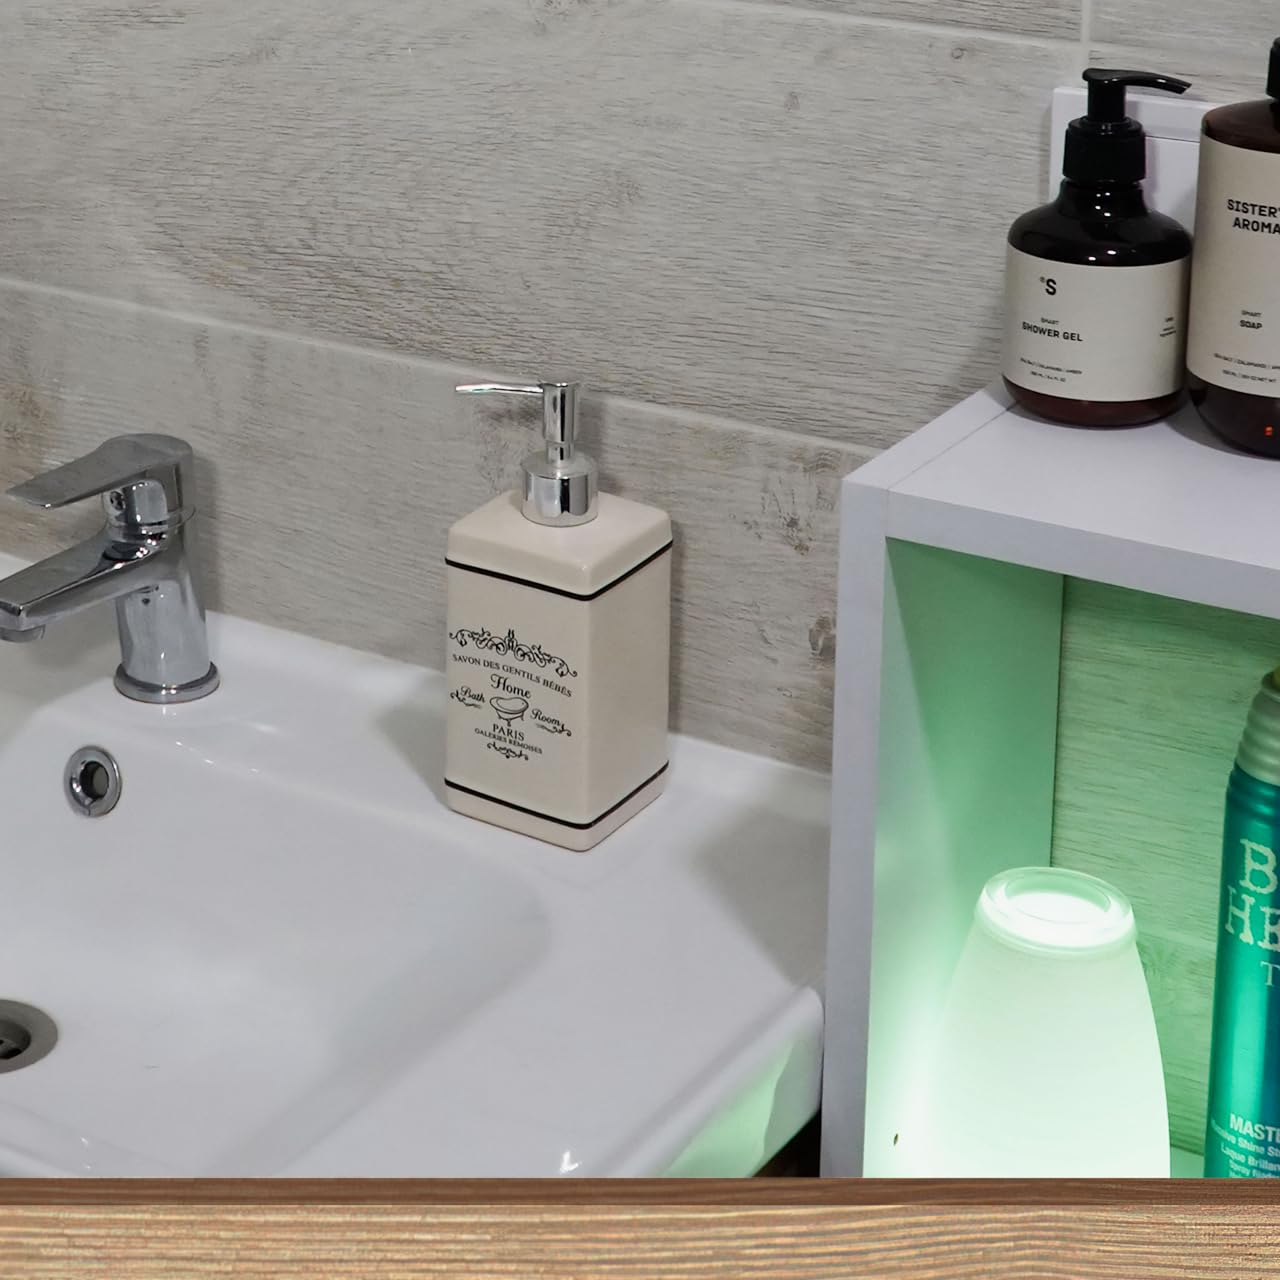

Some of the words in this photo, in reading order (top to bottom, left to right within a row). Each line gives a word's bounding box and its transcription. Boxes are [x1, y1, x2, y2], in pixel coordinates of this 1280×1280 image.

[1022, 321, 1060, 339] SHOWER
[1062, 331, 1083, 342] GEL
[1239, 319, 1263, 330] SOAP
[452, 653, 481, 667] SAVON
[483, 658, 501, 671] DES
[502, 664, 541, 684] GENTILS
[542, 678, 572, 698] BÉBÉS
[460, 685, 486, 704] Bath
[490, 673, 532, 699] Home
[530, 708, 561, 727] Room
[492, 723, 526, 742] PARIS
